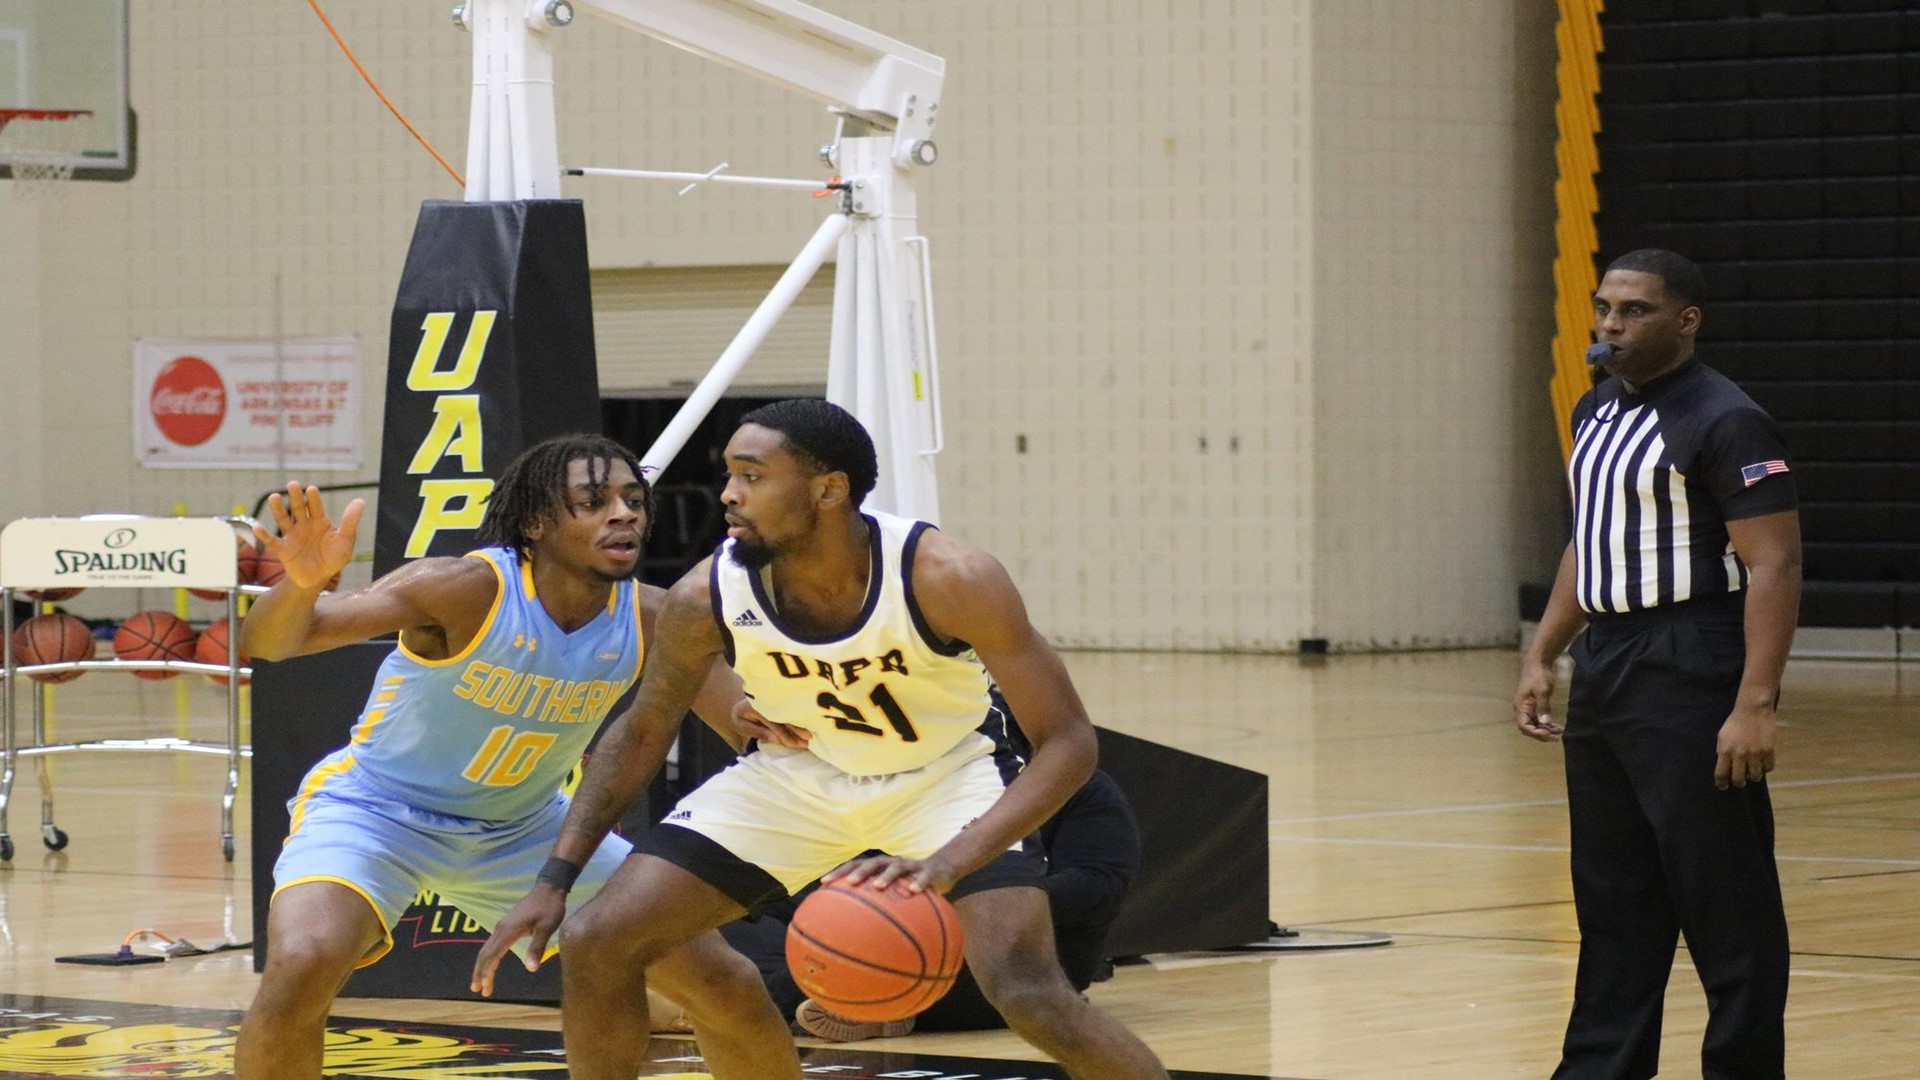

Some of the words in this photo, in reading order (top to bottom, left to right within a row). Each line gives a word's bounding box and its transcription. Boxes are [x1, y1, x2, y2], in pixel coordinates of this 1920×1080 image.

[404, 310, 498, 559] UAP
[55, 549, 186, 574] SPALDING
[816, 682, 919, 742] 21
[460, 725, 560, 787] 10
[431, 910, 481, 933] LIO
